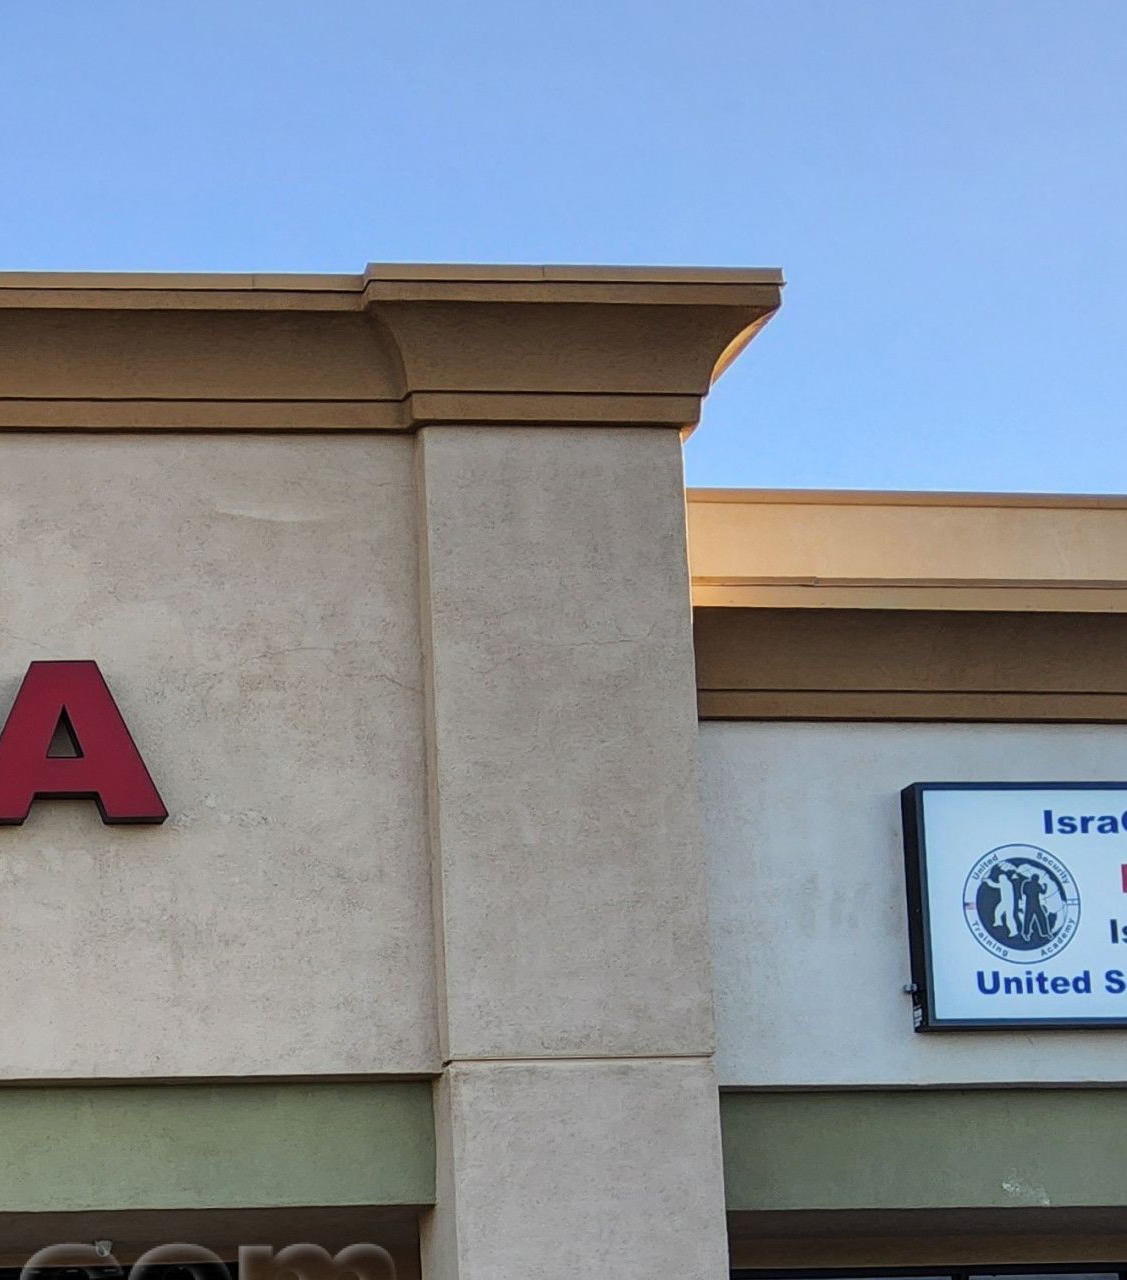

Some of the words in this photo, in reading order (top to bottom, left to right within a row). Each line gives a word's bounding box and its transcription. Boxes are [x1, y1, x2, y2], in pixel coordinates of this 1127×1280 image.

[972, 853, 999, 881] United
[1036, 852, 1070, 884] Security
[972, 920, 1009, 957] Training
[1041, 918, 1075, 957] Academy
[1110, 919, 1127, 943] I
[977, 970, 1091, 995] United
